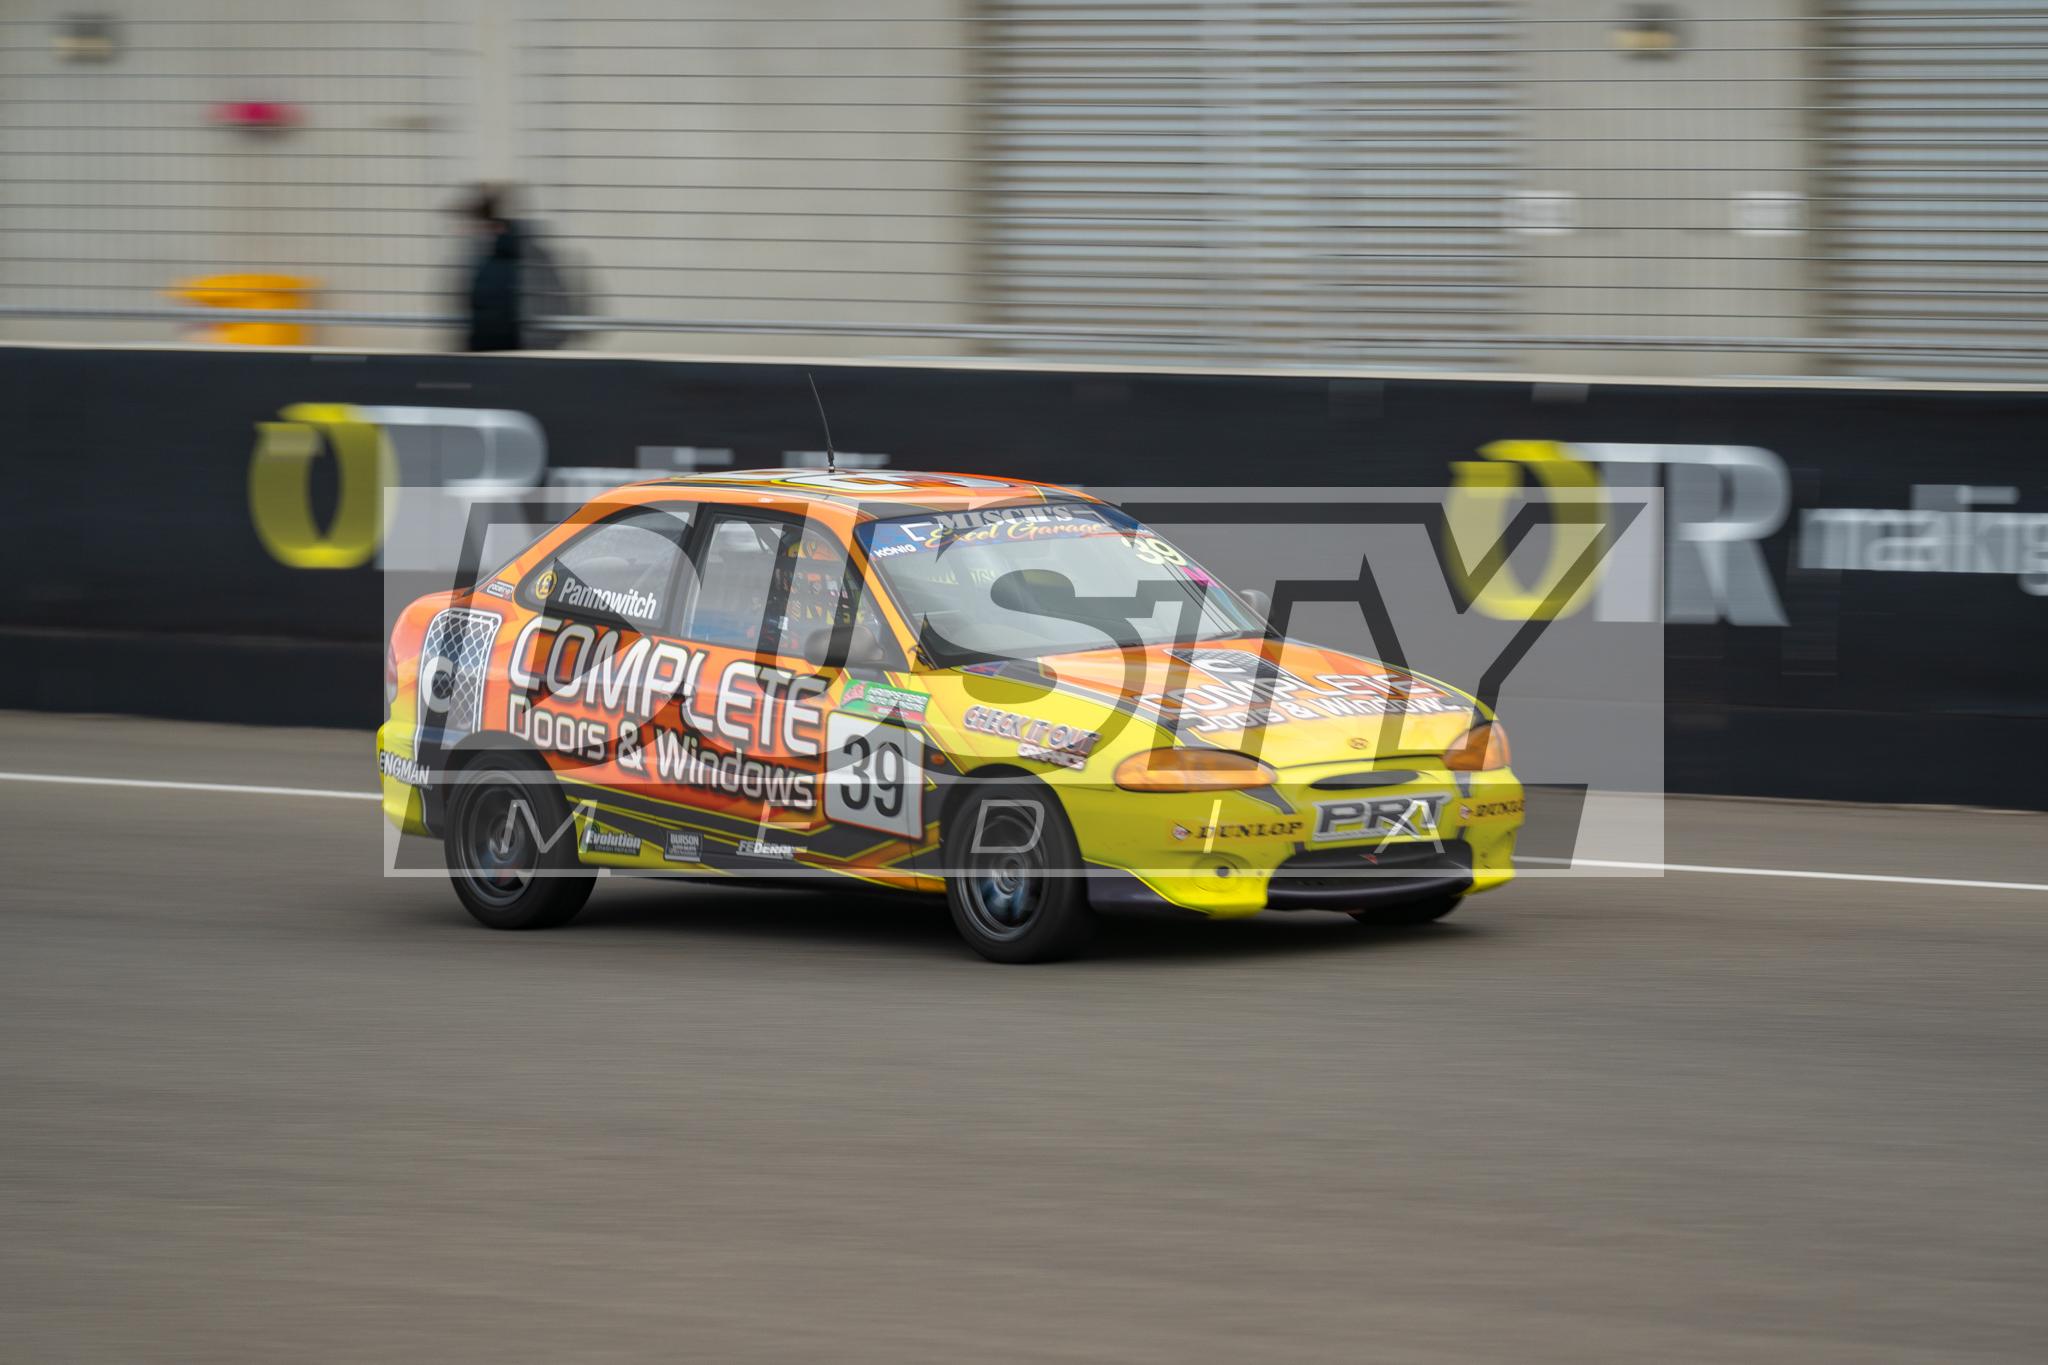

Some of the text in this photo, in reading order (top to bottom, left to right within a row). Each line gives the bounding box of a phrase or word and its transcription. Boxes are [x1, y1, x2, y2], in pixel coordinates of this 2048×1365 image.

[1007, 519, 1104, 540] Garage
[873, 543, 917, 559] KÖNIG
[1120, 536, 1187, 565] 39
[558, 577, 658, 620] Pannowitch
[508, 615, 829, 757] COMPLETE
[1132, 673, 1436, 714] COMPLETE
[963, 704, 1031, 741] CHECK
[1281, 700, 1320, 720] &
[509, 692, 817, 810] Doors & Windows
[839, 734, 904, 819] 39
[1196, 821, 1305, 841] DUNLOP
[1313, 793, 1454, 842] PRT
[587, 829, 642, 850] Evolution
